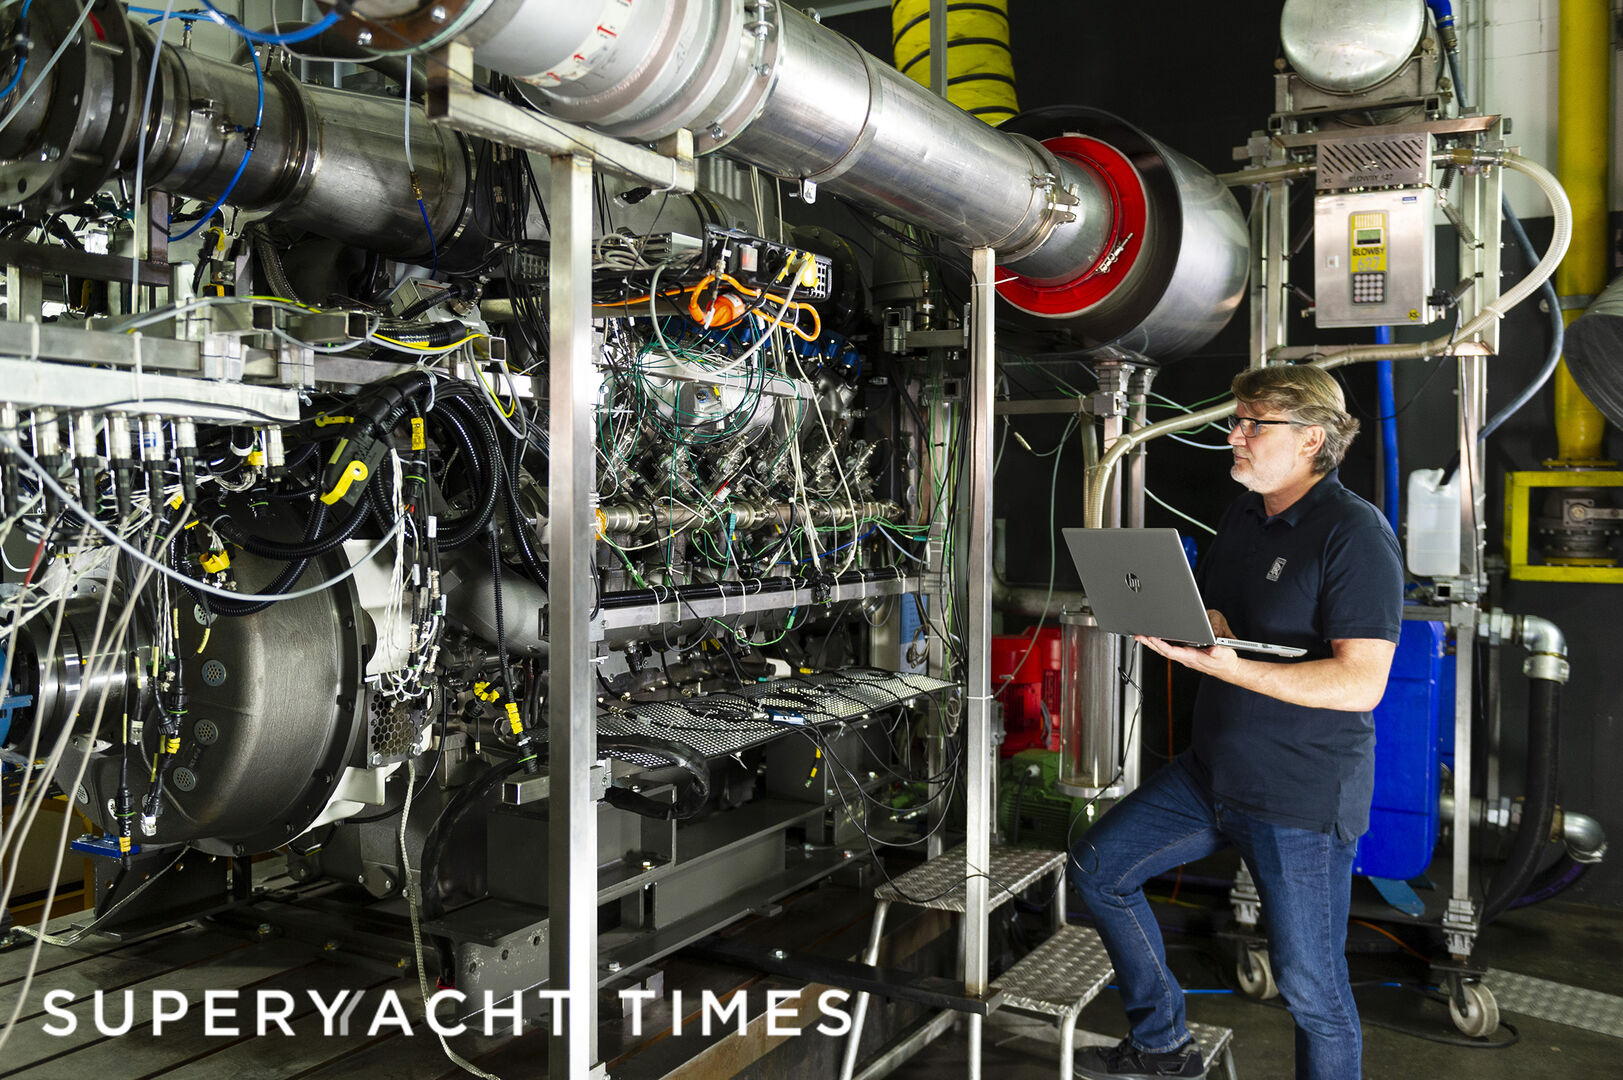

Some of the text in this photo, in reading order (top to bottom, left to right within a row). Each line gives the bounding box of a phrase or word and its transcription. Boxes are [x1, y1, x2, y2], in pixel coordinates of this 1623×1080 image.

[1352, 248, 1385, 257] BLOWBY
[1357, 256, 1381, 271] 627
[1128, 572, 1141, 593] hp
